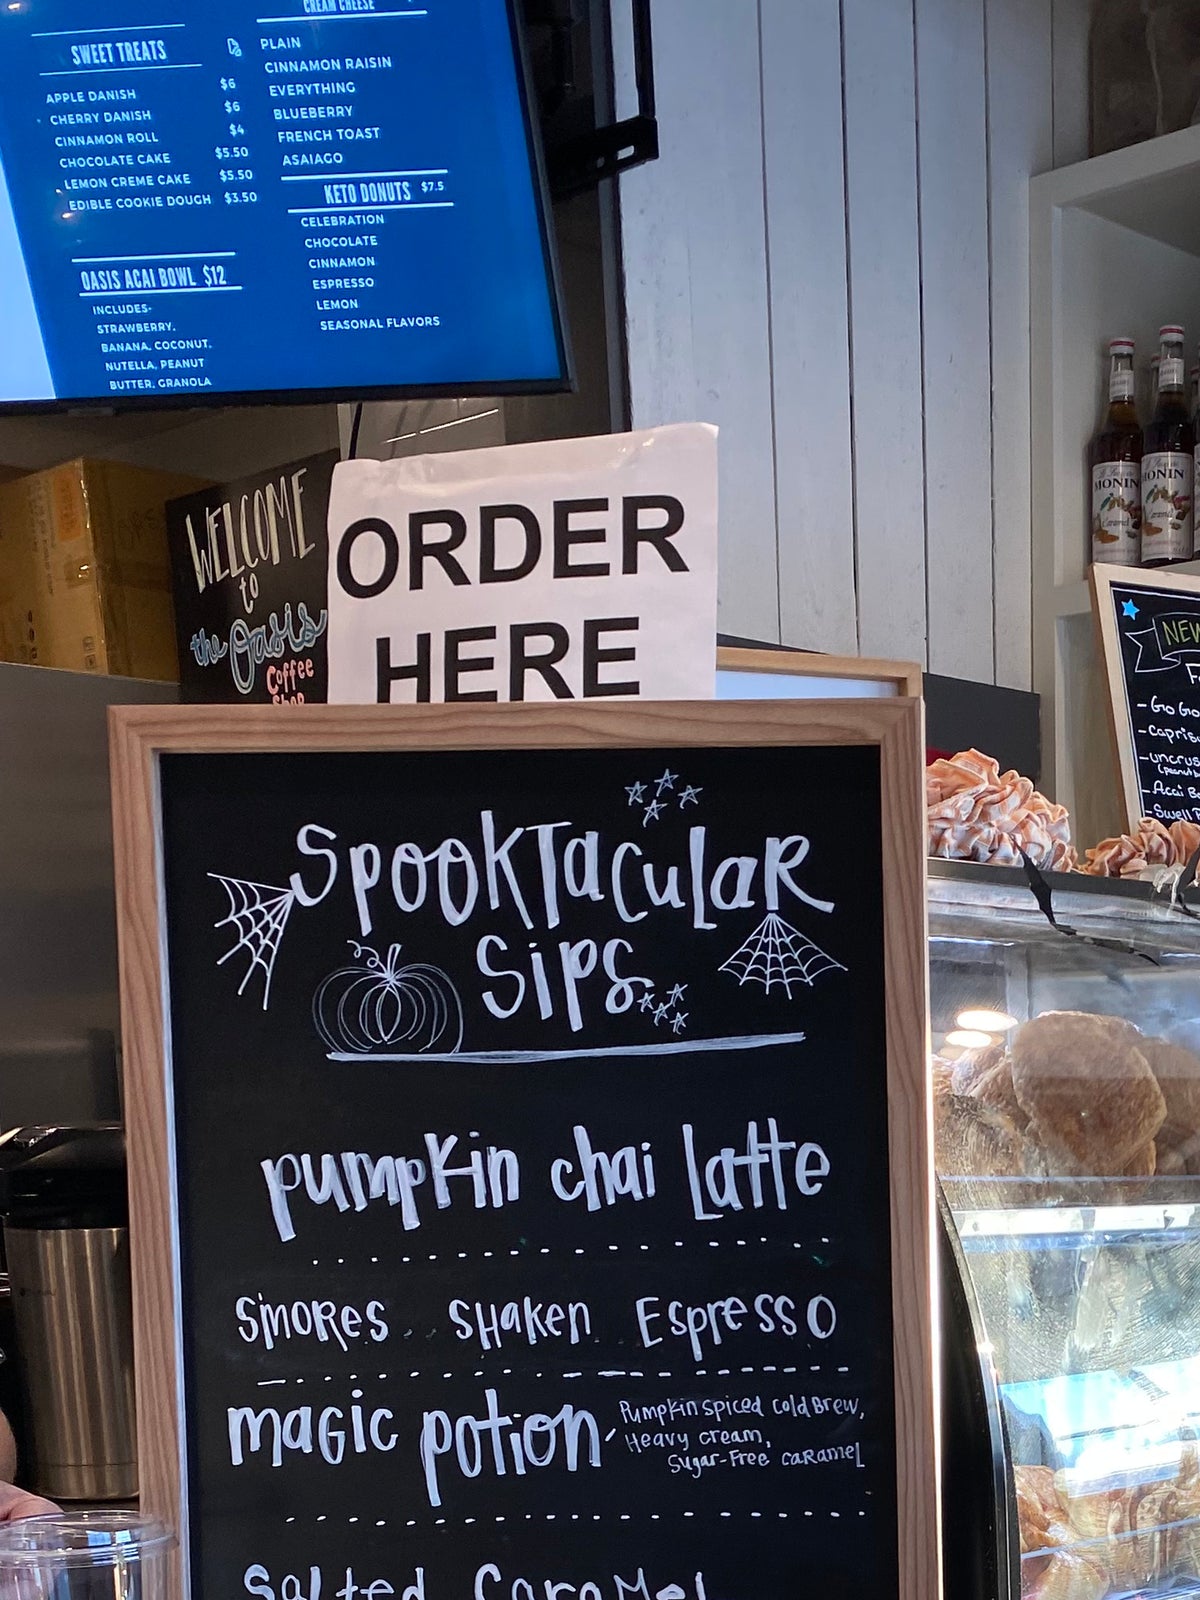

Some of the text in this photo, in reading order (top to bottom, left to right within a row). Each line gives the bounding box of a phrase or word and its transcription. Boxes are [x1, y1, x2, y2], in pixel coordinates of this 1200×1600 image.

[71, 40, 167, 66] SWEET TREATS
[260, 38, 301, 50] PLAIN
[264, 57, 392, 74] CINNAMON RAISIN
[46, 77, 236, 104] APPLE DANISH $6
[269, 81, 355, 97] EVERYTHING
[50, 100, 240, 126] CHERRY DANISH $6
[273, 105, 353, 120] BLUEBERRY
[55, 123, 245, 147] CINNAMON ROLL $4
[278, 127, 380, 143] FRENCH TOAST
[59, 146, 249, 168] CHOCOLATE CAKE $5.50
[282, 152, 343, 167] ASAIAGO
[64, 169, 253, 190] LEMON CREME CAKE $5.50
[68, 191, 258, 211] EDIBLE COOKIE DOUGH $3.50
[324, 184, 357, 204] KETO
[360, 182, 411, 203] DONUTS
[301, 214, 384, 227] CELEBRATION
[305, 235, 378, 249] CHOCOLATE
[308, 256, 375, 270] CINNAMON
[81, 265, 227, 291] OASIS ACAI BOWL $12
[313, 278, 375, 290] ESPRESSO
[316, 299, 359, 311] LEMON
[320, 315, 440, 331] SEASONAL FLAVORS
[161, 358, 204, 369] PEANUT
[158, 377, 212, 388] GRANOLA
[185, 467, 316, 594] WELCOME
[336, 494, 690, 599] ORDER
[239, 573, 259, 614] to
[190, 602, 328, 695] the Oasis
[376, 617, 641, 703] HERE
[266, 658, 314, 695] Coffee
[1150, 696, 1175, 716] Go
[1179, 702, 1200, 718] Go
[1153, 804, 1192, 821] Swell
[550, 1125, 655, 1211] chai
[624, 1431, 689, 1453] Heavy
